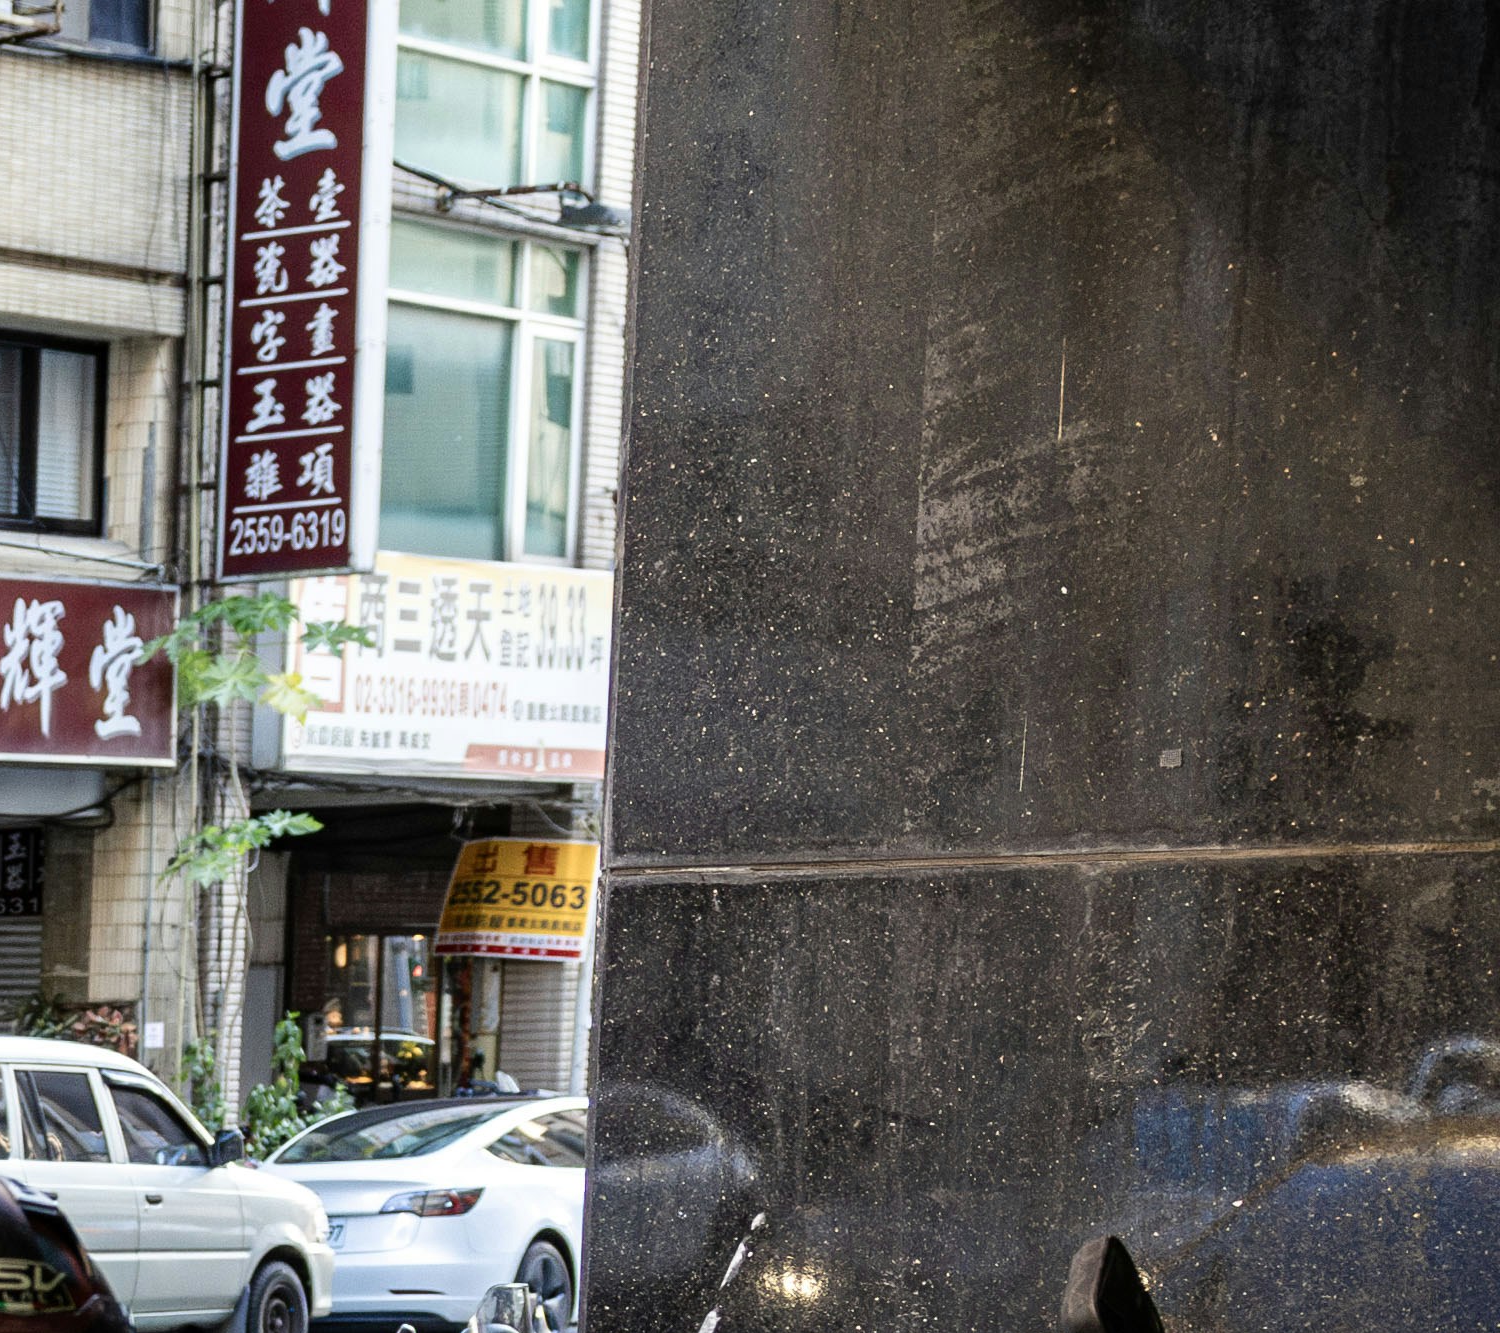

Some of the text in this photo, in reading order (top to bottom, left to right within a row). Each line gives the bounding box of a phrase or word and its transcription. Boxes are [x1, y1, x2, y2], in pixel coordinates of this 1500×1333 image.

[265, 0, 345, 162] 堂
[245, 371, 343, 433] 玉器
[228, 508, 347, 557] 2559-6319
[449, 880, 587, 910] 2552-5063
